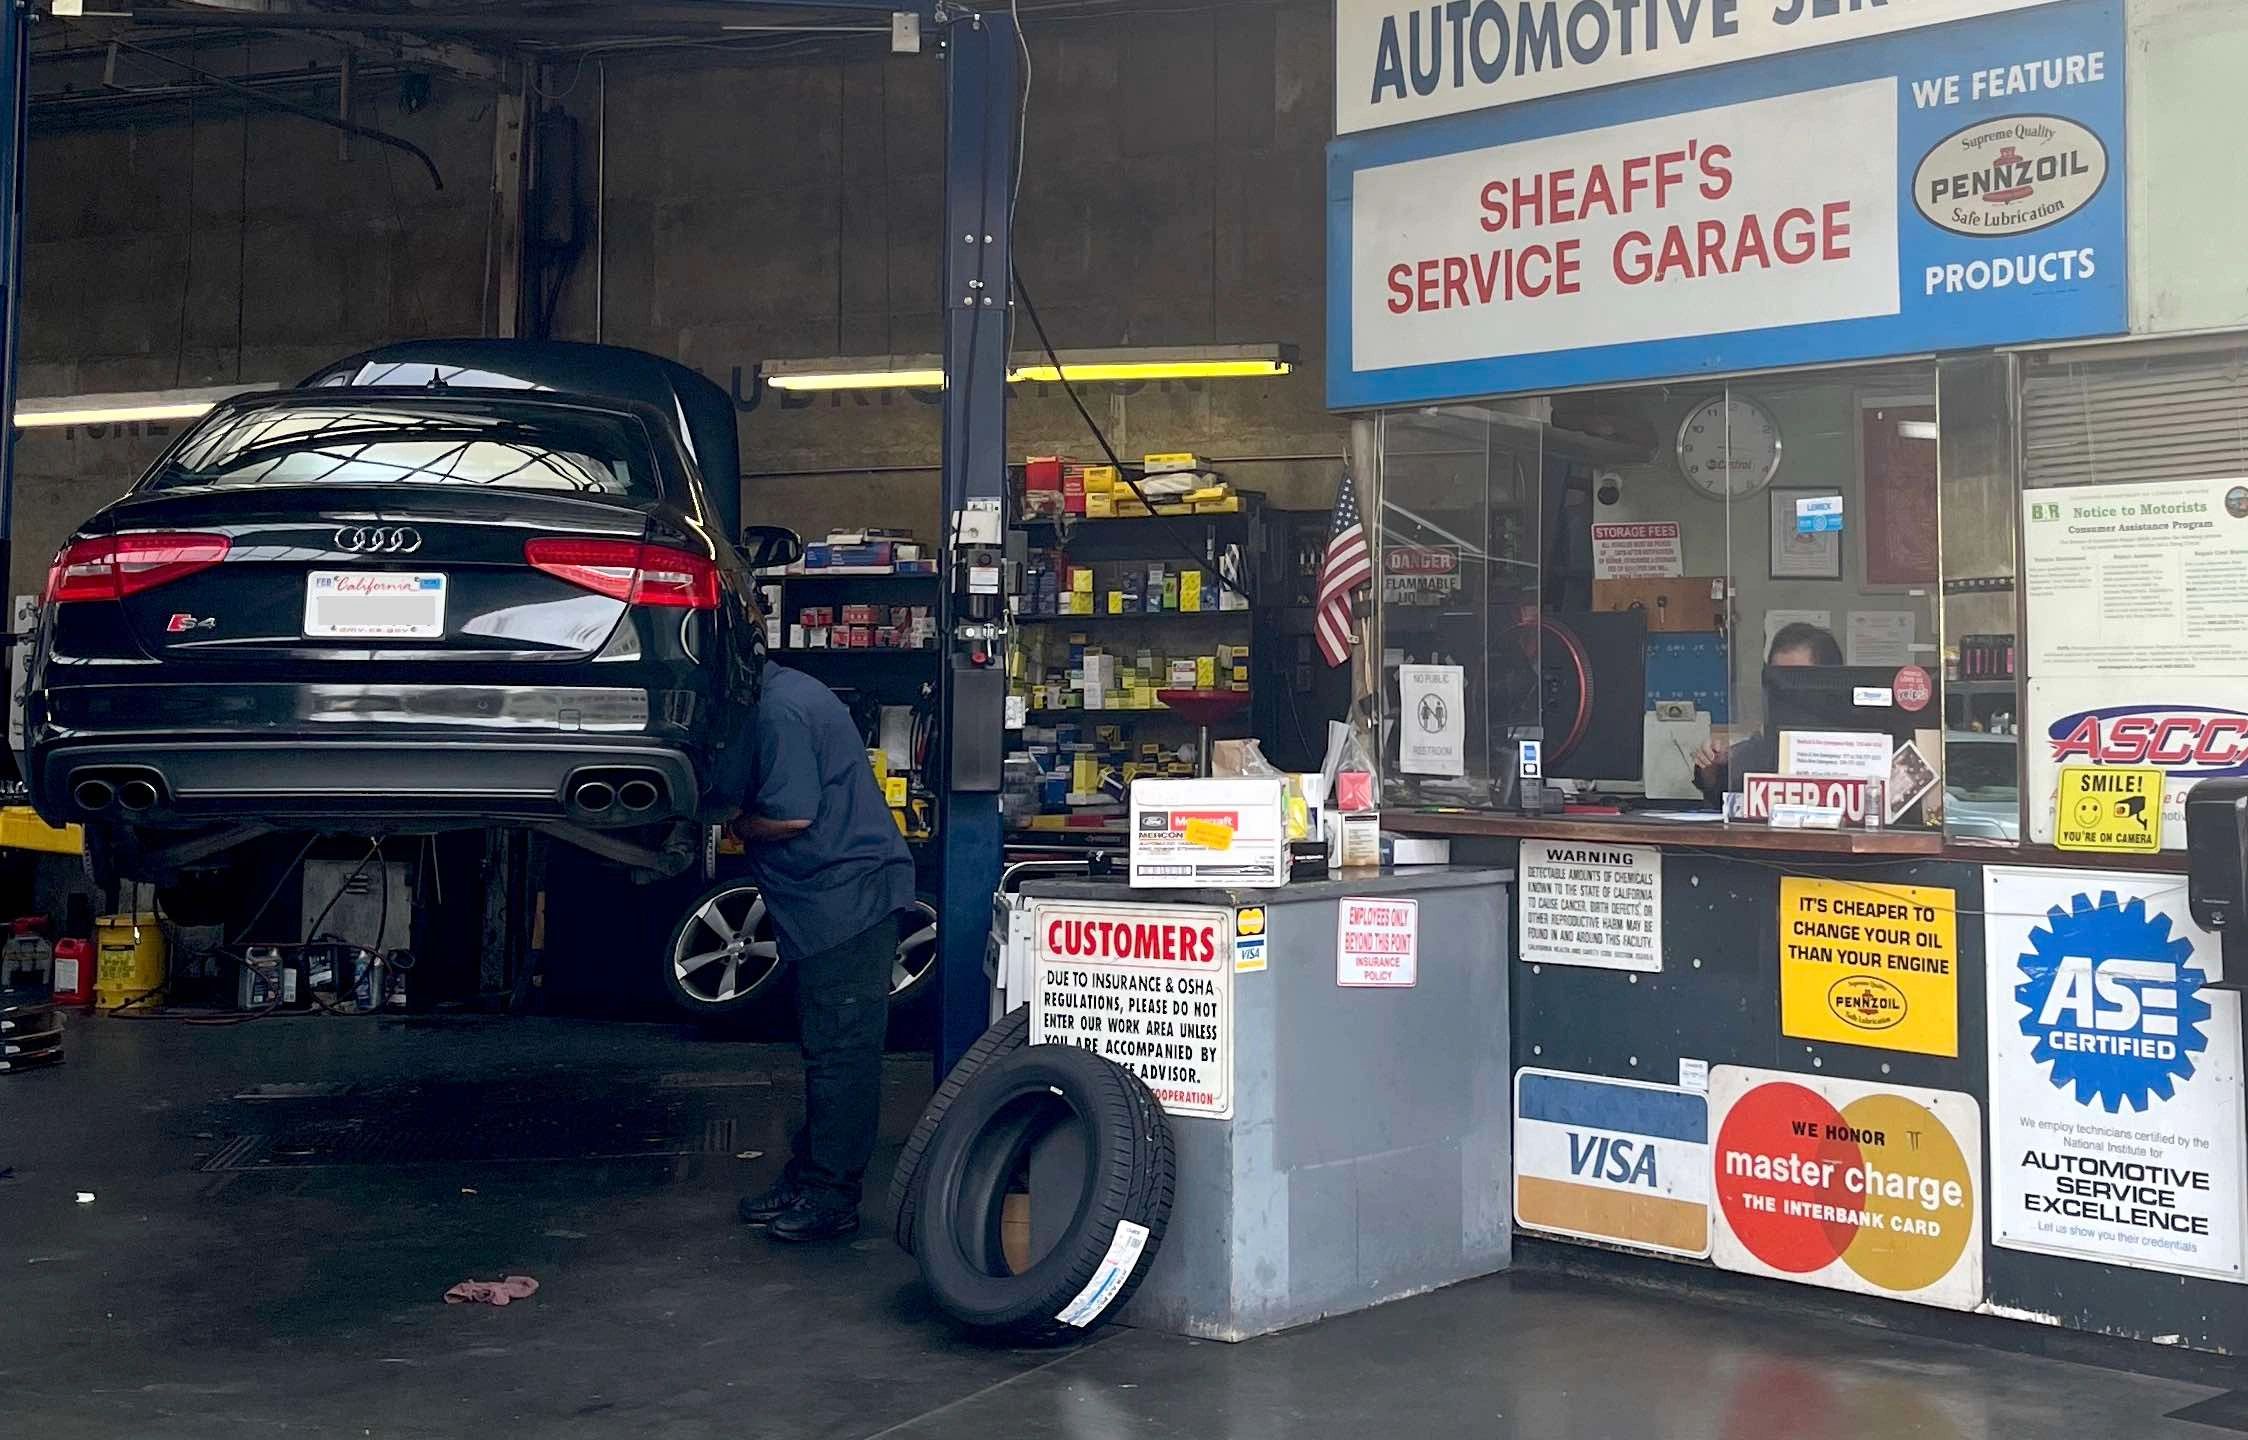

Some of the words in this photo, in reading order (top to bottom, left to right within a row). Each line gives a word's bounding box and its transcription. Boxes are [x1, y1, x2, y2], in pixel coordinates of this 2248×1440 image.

[1371, 0, 1738, 104] AUTOMOTIVE
[1912, 75, 1959, 108] WE
[1972, 51, 2105, 100] FEATURE
[1962, 128, 2013, 151] Supreme
[2015, 122, 2056, 145] Quality
[1480, 139, 1732, 232] SHEAFF'S
[1931, 150, 2089, 204] PENNZOIL
[1952, 207, 1980, 226] Safe
[1984, 200, 2065, 226] Lubrication
[1387, 239, 1580, 314] SERVICE
[1612, 201, 1851, 285] GARAGE
[1926, 248, 2095, 295] PRODUCTS
[2073, 506, 2117, 519] Notice
[2122, 506, 2135, 516] to
[2140, 501, 2208, 516] Motorists
[1596, 527, 1646, 538] STORAGE
[1648, 526, 1676, 537] FEES
[2069, 525, 2117, 534] Consumer
[2118, 521, 2169, 533] Assistance
[2172, 520, 2214, 532] Program
[1392, 553, 1451, 569] DANGER
[337, 576, 413, 595] California
[1385, 577, 1457, 591] FLAMMABLE
[2046, 716, 2248, 764] ASCC
[2081, 774, 2143, 792] SMILE!
[1826, 783, 1866, 821] OU
[2063, 831, 2097, 843] YOU'RE
[2100, 832, 2113, 843] ON
[2116, 833, 2153, 845] CAMERA
[1546, 849, 1633, 864] WARNING
[1528, 866, 1566, 880] DETECTABLE
[1569, 868, 1600, 881] AMOUNTS
[1604, 871, 1612, 882] OF
[1614, 872, 1653, 885] CHEMICALS
[1538, 897, 1558, 909] CAUSE
[1554, 883, 1562, 894] TO
[1565, 884, 1577, 896] THE
[1580, 885, 1599, 897] STATE
[1602, 886, 1611, 898] OF
[1613, 887, 1653, 900] CALIFORNIA
[1350, 907, 1390, 926] EMPLOYEES
[1391, 908, 1409, 926] ONLY
[1800, 897, 1827, 913] IT'S
[1833, 900, 1908, 920] CHEAPER
[1913, 907, 1935, 922] TO
[1551, 914, 1600, 929] REPRODUCTIVE
[1603, 918, 1624, 930] HARM
[1626, 920, 1641, 932] MAY
[1644, 920, 1653, 932] BE
[1793, 921, 1860, 941] CHANGE
[1864, 927, 1910, 945] YOUR
[1916, 932, 1942, 949] OIL
[1049, 920, 1214, 963] CUSTOMERS
[1345, 932, 1373, 950] BEYOND
[1375, 932, 1389, 950] THIS
[1391, 934, 1411, 952] POINT
[1550, 929, 1558, 940] IN
[1560, 930, 1574, 942] AND
[1576, 931, 1602, 944] AROUND
[1605, 934, 1621, 946] THIS
[1242, 948, 1260, 960] VISA
[1356, 957, 1400, 967] INSURANCE
[1788, 944, 1832, 962] THAN
[1836, 949, 1881, 967] YOUR
[1887, 954, 1949, 975] ENGINE
[1047, 970, 1069, 987] DUE
[1073, 971, 1088, 988] TO
[1092, 973, 1161, 993] INSURANCE
[1166, 978, 1174, 993] &
[1178, 977, 1213, 996] OSHA
[1364, 971, 1392, 981] POLICY
[1044, 992, 1124, 1014] REGULATIONS,
[1129, 997, 1168, 1015] PLEASE
[1173, 1001, 1189, 1016] DO
[1194, 1002, 1217, 1018] NOT
[1836, 996, 1900, 1010] PENNZOIL
[2038, 956, 2178, 1036] ASE
[1044, 1013, 1075, 1030] ENTER
[1081, 1015, 1102, 1032] OUR
[1108, 1018, 1139, 1034] WORK
[1146, 1020, 1174, 1037] AREA
[1180, 1022, 1217, 1041] UNLESS
[1076, 1036, 1098, 1053] ARE
[1105, 1039, 1193, 1060] ACCOMPANIED
[1201, 1046, 1217, 1062] BY
[2049, 1030, 2177, 1060] CERTIFIED
[1141, 1064, 1201, 1084] ADVISOR.
[1792, 1120, 1820, 1138] WE
[1825, 1123, 1886, 1146] HONOR
[2019, 1117, 2035, 1128] We
[2038, 1120, 2074, 1134] employ
[2076, 1123, 2134, 1139] technicians
[2134, 1130, 2175, 1146] certified
[2177, 1134, 2190, 1148] by
[2192, 1137, 2210, 1149] the
[2063, 1136, 2104, 1152] National
[2108, 1142, 2147, 1157] Institute
[1567, 1132, 1657, 1188] VISA
[2021, 1150, 2210, 1191] AUTOMOTIVE
[1726, 1149, 1837, 1189] master
[1844, 1162, 1963, 1211] charge
[2056, 1176, 2176, 1209] SERVICE
[1742, 1192, 1776, 1213] THE
[1783, 1199, 1884, 1229] INTERBANK
[1890, 1214, 1941, 1237] CARD
[2024, 1193, 2209, 1236] EXCELLENCE
[2055, 1225, 2067, 1233] us
[2070, 1225, 2096, 1238] show
[2097, 1231, 2116, 1243] you
[2118, 1231, 2140, 1244] their
[2141, 1235, 2198, 1252] credentials
